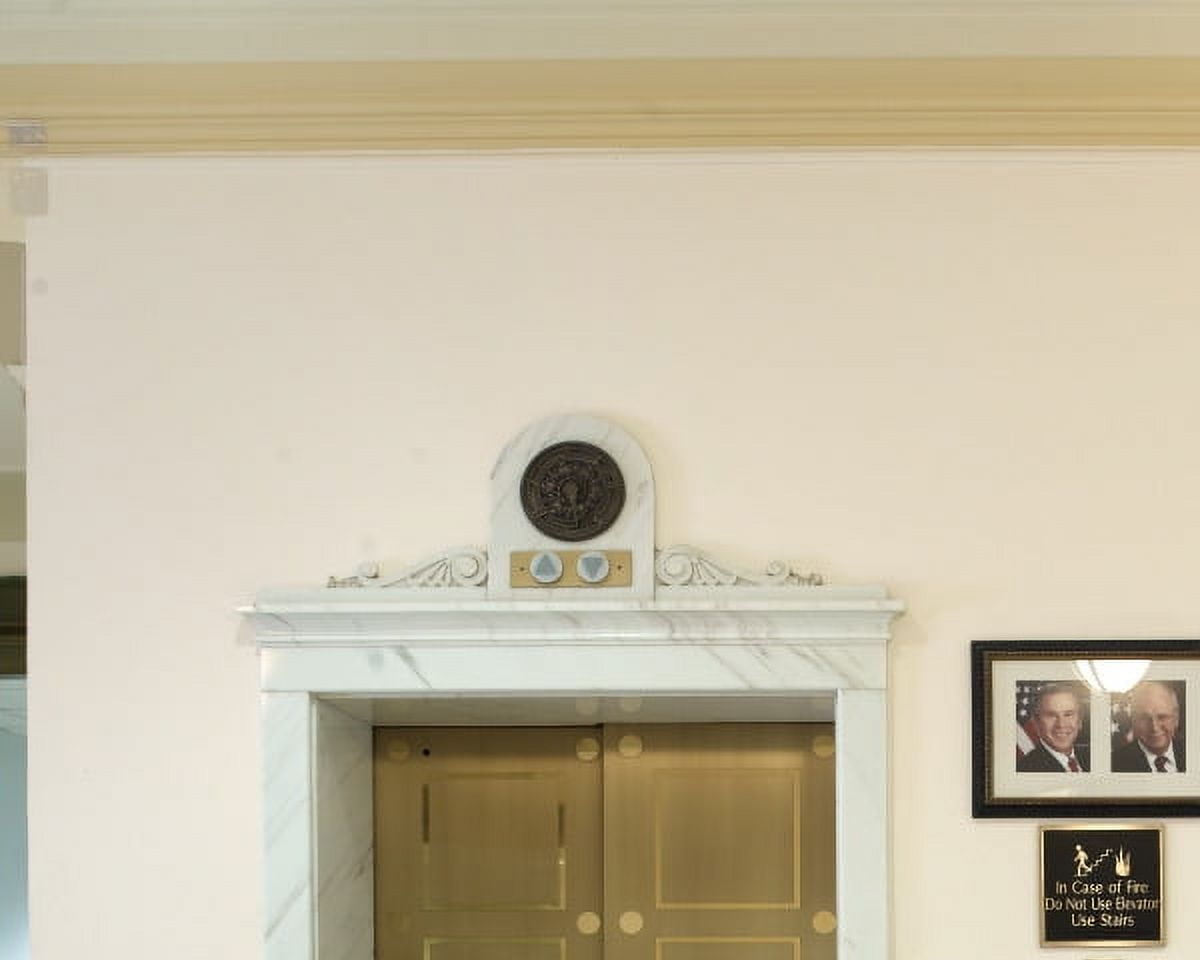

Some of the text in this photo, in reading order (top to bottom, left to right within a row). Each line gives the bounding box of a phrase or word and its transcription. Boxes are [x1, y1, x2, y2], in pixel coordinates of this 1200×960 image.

[1055, 880, 1149, 894] In Case of Fire
[1045, 898, 1063, 911] Do
[1065, 898, 1087, 911] Not
[1091, 897, 1112, 911] Use
[1071, 913, 1135, 927] Use Stairs
